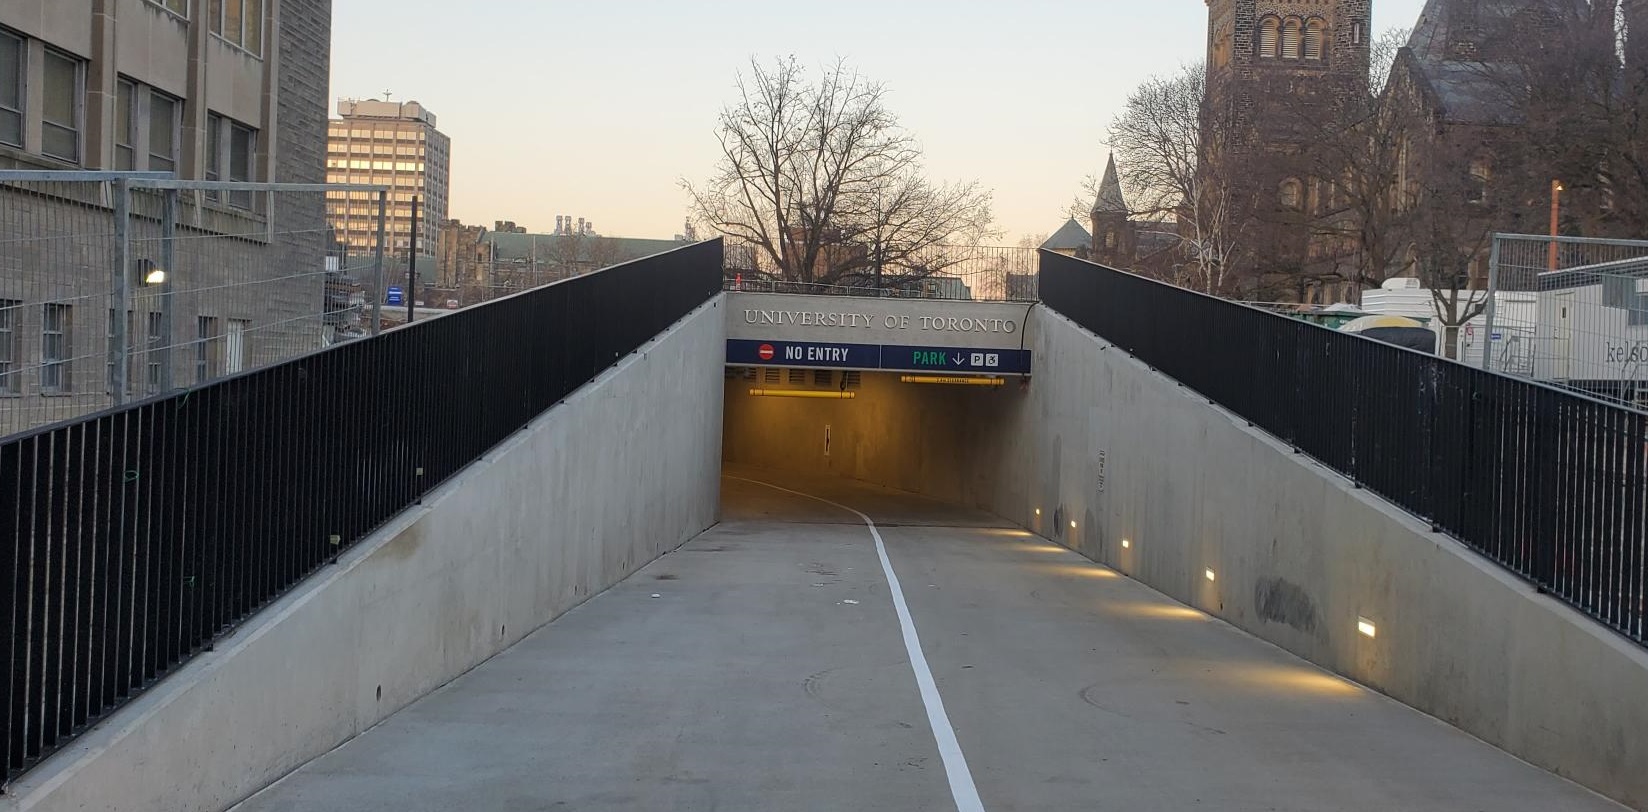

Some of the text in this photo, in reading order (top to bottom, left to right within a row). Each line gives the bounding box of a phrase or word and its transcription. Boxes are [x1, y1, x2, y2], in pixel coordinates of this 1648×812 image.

[744, 309, 1017, 334] UNIVERSITY OF TORONTO
[785, 346, 849, 362] NO ENTRY
[913, 351, 947, 365] PARK
